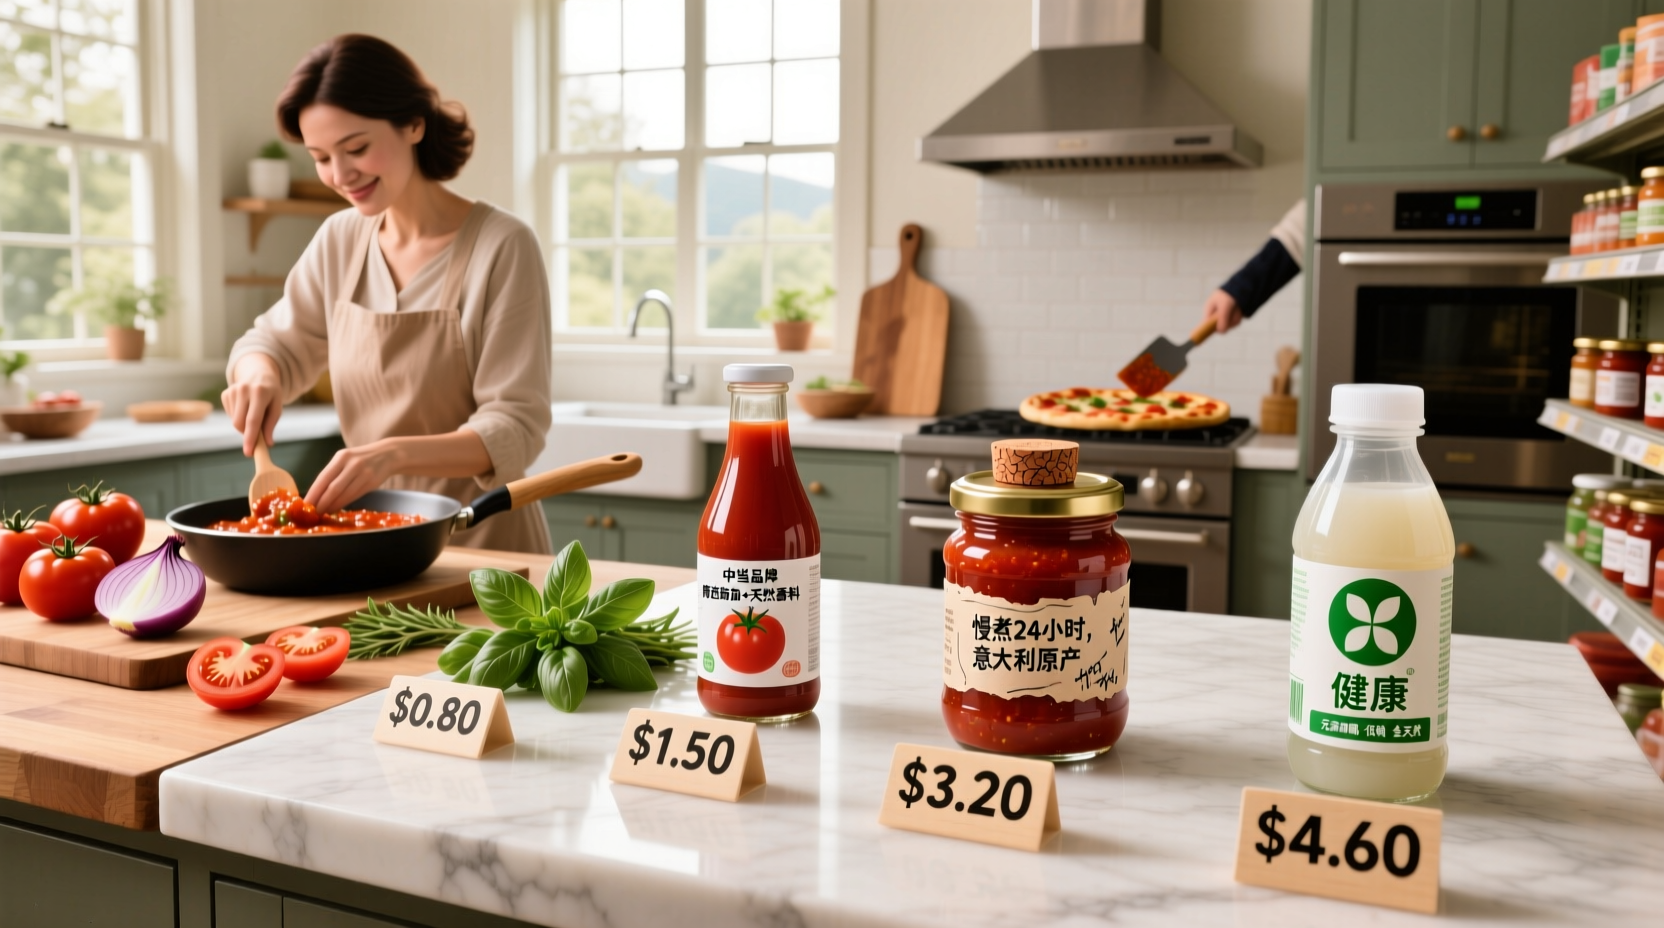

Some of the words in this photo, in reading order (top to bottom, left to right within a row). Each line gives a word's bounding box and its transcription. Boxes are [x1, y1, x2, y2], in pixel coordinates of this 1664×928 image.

[972, 644, 1081, 673] 意大利原产
[389, 686, 481, 736] $0.80
[1331, 671, 1409, 713] 健康
[628, 719, 735, 775] $1.50
[898, 756, 1032, 821] $3.20
[1255, 804, 1421, 878] $4.60
